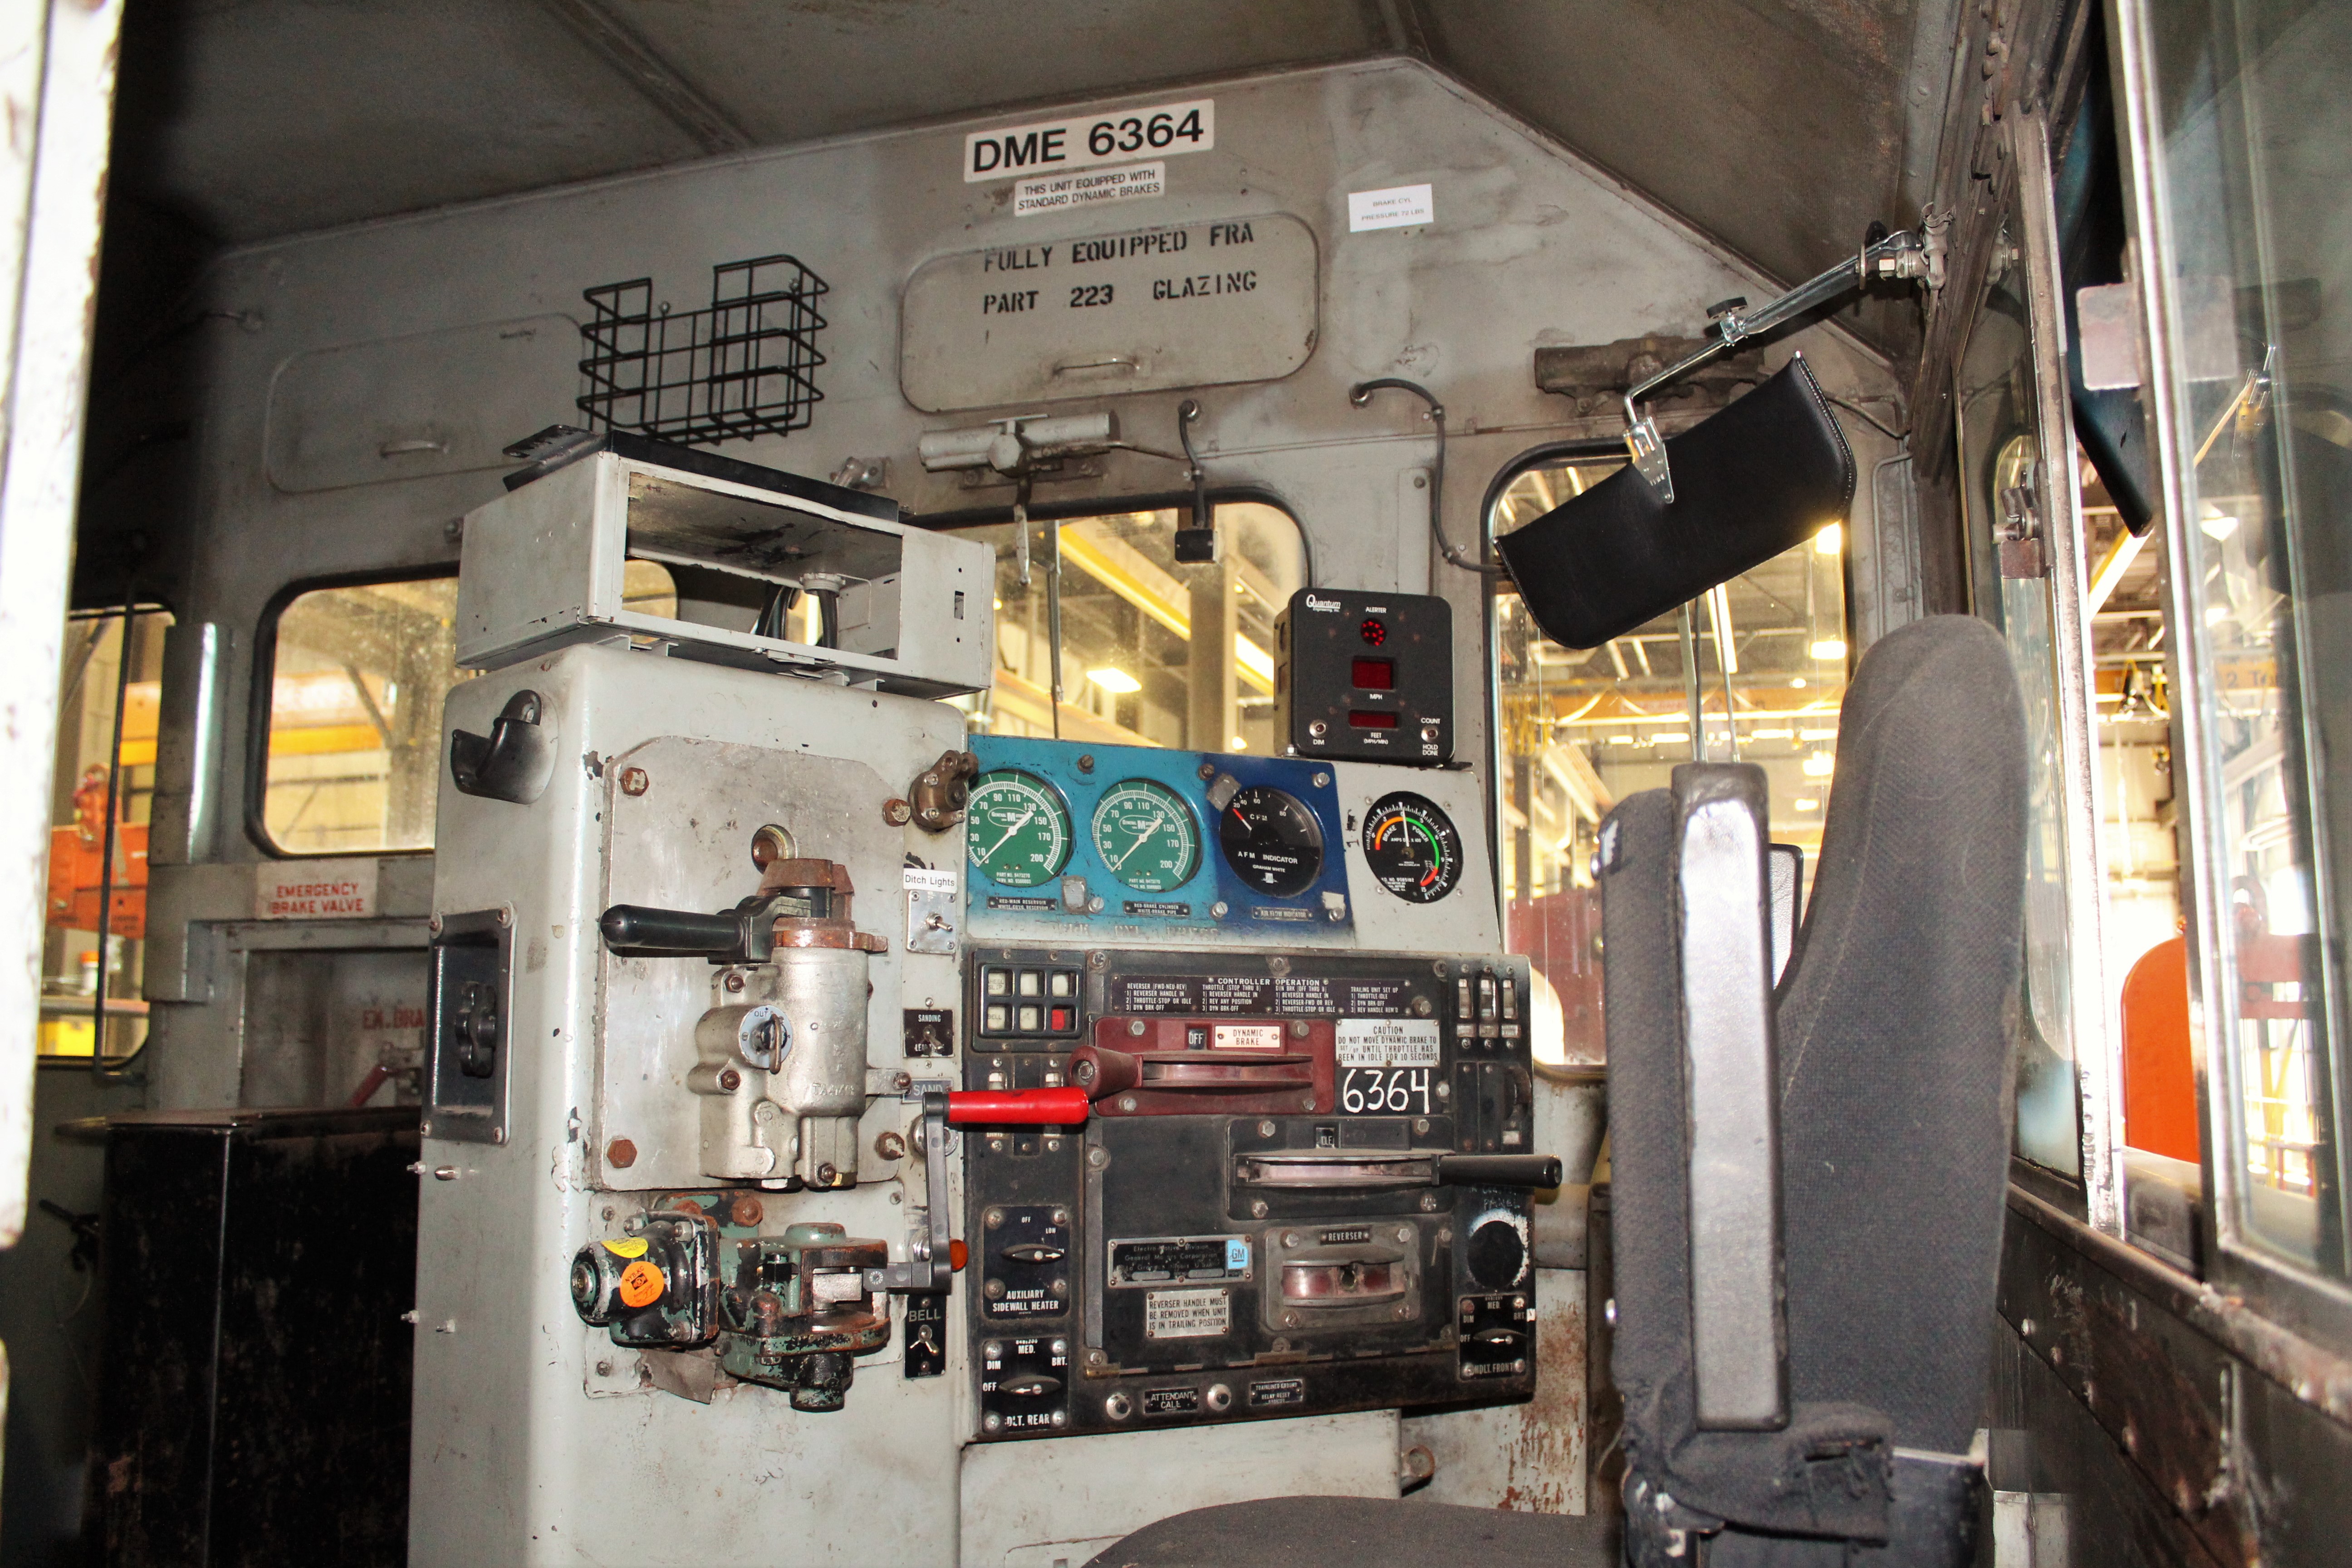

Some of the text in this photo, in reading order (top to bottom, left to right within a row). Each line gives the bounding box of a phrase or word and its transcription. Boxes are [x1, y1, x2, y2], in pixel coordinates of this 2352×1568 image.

[974, 109, 1204, 172] DME 6364
[1024, 169, 1156, 195] THIS UNIT EQUIPPED WITH
[1018, 182, 1160, 210] STANDARD DYNAMIC BRAKES
[1362, 211, 1398, 220] PRESSURE
[984, 222, 1254, 272] FULLY EQUIPPED FRA
[984, 270, 1257, 314] PART 223 GLAZING
[1306, 594, 1341, 608] Quantum
[993, 794, 1002, 802] 90
[1008, 794, 1020, 802] 110
[979, 801, 988, 810] 70
[1024, 803, 1036, 811] 130
[970, 816, 980, 825] 50
[1035, 817, 1047, 825] 150
[970, 833, 979, 842] 30
[1038, 833, 1051, 841] 170
[1382, 824, 1397, 842] BRAKE
[1412, 825, 1429, 843] POWER
[1103, 841, 1112, 849] 30
[1167, 839, 1179, 848] 170
[977, 848, 986, 856] 10
[1030, 854, 1044, 862] 200
[1263, 854, 1298, 864] INDICATOR
[1160, 860, 1173, 868] 200
[905, 874, 955, 887] Ditch Lights
[276, 882, 359, 898] EMERGENCY
[271, 898, 364, 914] BRAKE VALVE
[918, 1014, 941, 1022] SANDING
[1233, 1029, 1263, 1037] DYNAMIC
[1373, 1026, 1403, 1034] CAUTION
[1189, 1032, 1204, 1044] OFF
[1236, 1038, 1259, 1046] BRAKE
[1343, 1068, 1430, 1115] 6364
[1328, 1231, 1362, 1241] REVERSER
[1232, 1249, 1244, 1259] GM
[1006, 1289, 1044, 1300] AUXILIARY
[993, 1300, 1058, 1312] SIDEWALL HEATER
[1150, 1297, 1226, 1309] REVERSER HANDLE MUST
[909, 1308, 941, 1322] BELL
[1150, 1308, 1226, 1319] BE REMOVED WHEN UNIT
[1159, 1321, 1165, 1329] IN
[1169, 1319, 1196, 1328] TRAILING
[1199, 1318, 1226, 1327] POSITION
[1463, 1315, 1474, 1323] DIM
[1460, 1334, 1470, 1343] OFF
[1018, 1345, 1035, 1354] MED.
[987, 1360, 1001, 1370] DIM
[1052, 1357, 1068, 1367] BRT.
[1493, 1362, 1514, 1372] FRONT
[982, 1382, 997, 1392] OFF
[1151, 1391, 1194, 1401] ATTENDANT
[1161, 1400, 1181, 1409] CALL
[1005, 1413, 1050, 1427] DLT. REAR
